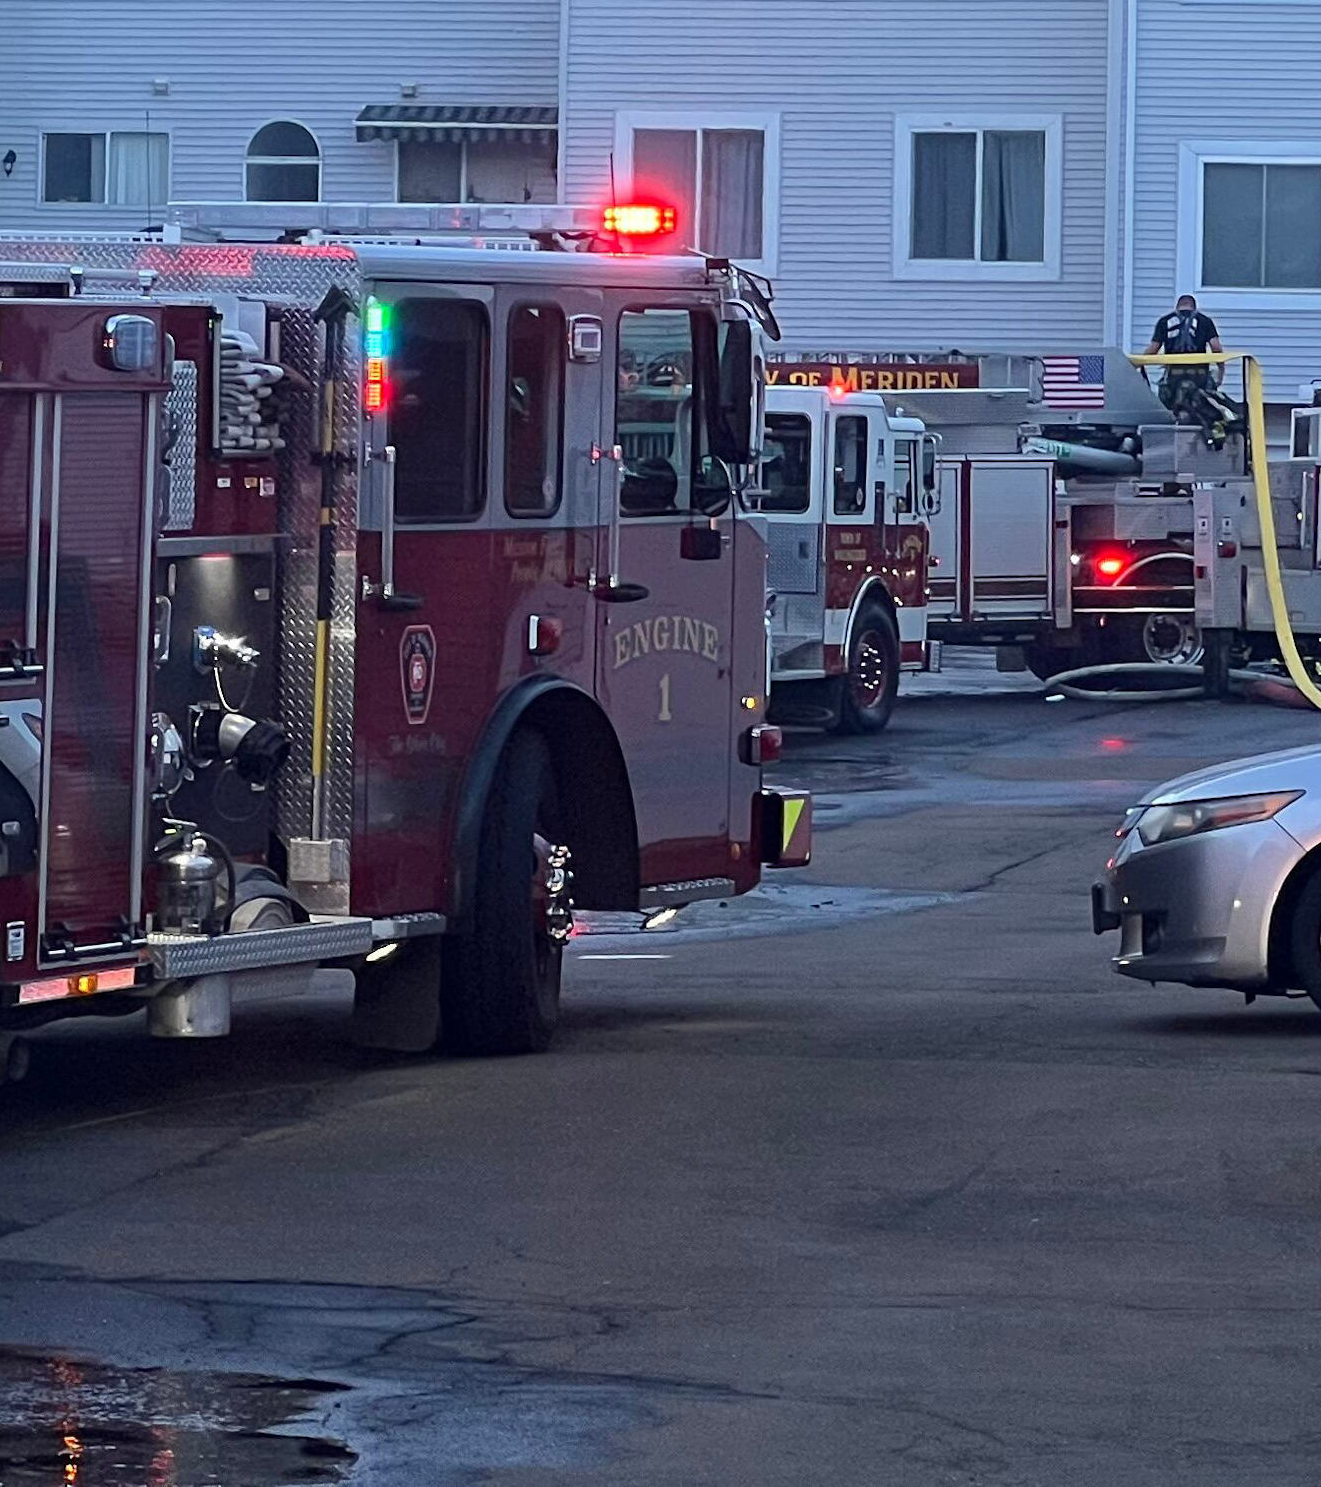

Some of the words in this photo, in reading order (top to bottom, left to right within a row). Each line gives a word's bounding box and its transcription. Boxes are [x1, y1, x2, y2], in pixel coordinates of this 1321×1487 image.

[831, 366, 959, 390] MERIDEN
[614, 616, 718, 669] ENGINE
[659, 674, 672, 721] 1
